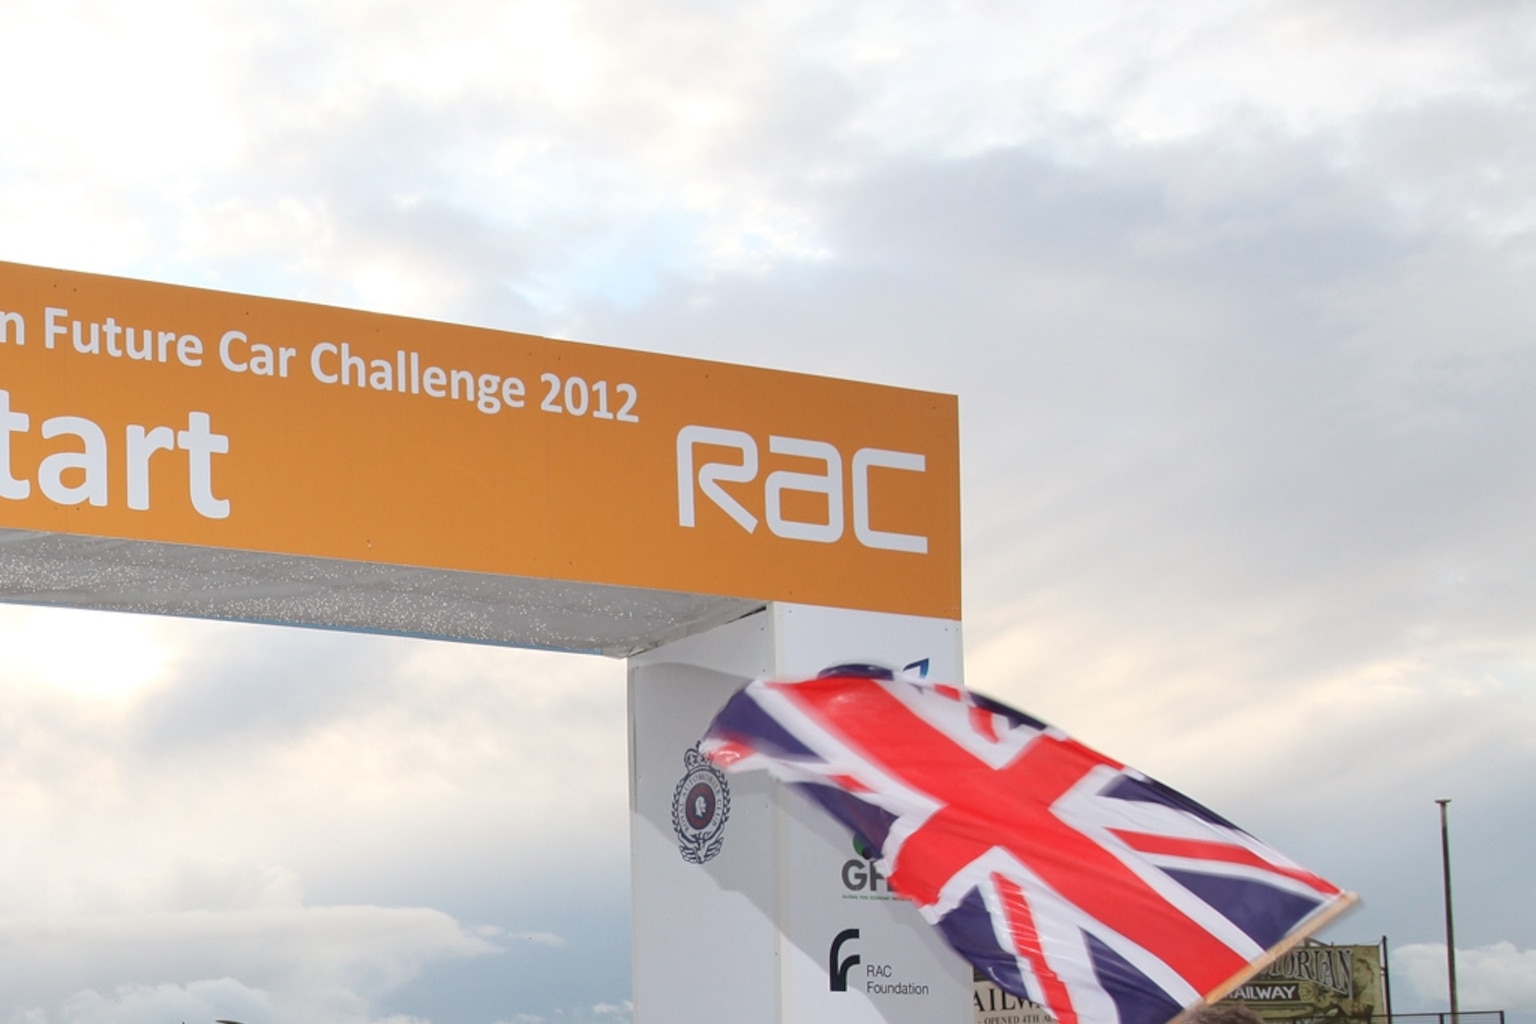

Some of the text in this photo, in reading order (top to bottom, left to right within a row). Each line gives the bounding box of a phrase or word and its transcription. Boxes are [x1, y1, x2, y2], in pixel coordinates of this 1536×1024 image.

[44, 307, 203, 368] Future
[219, 330, 295, 378] Car
[309, 341, 526, 415] Challenge
[539, 372, 639, 424] 2012
[866, 965, 892, 978] RAC
[866, 982, 929, 995] Foundation
[1228, 985, 1296, 999] AILWAY
